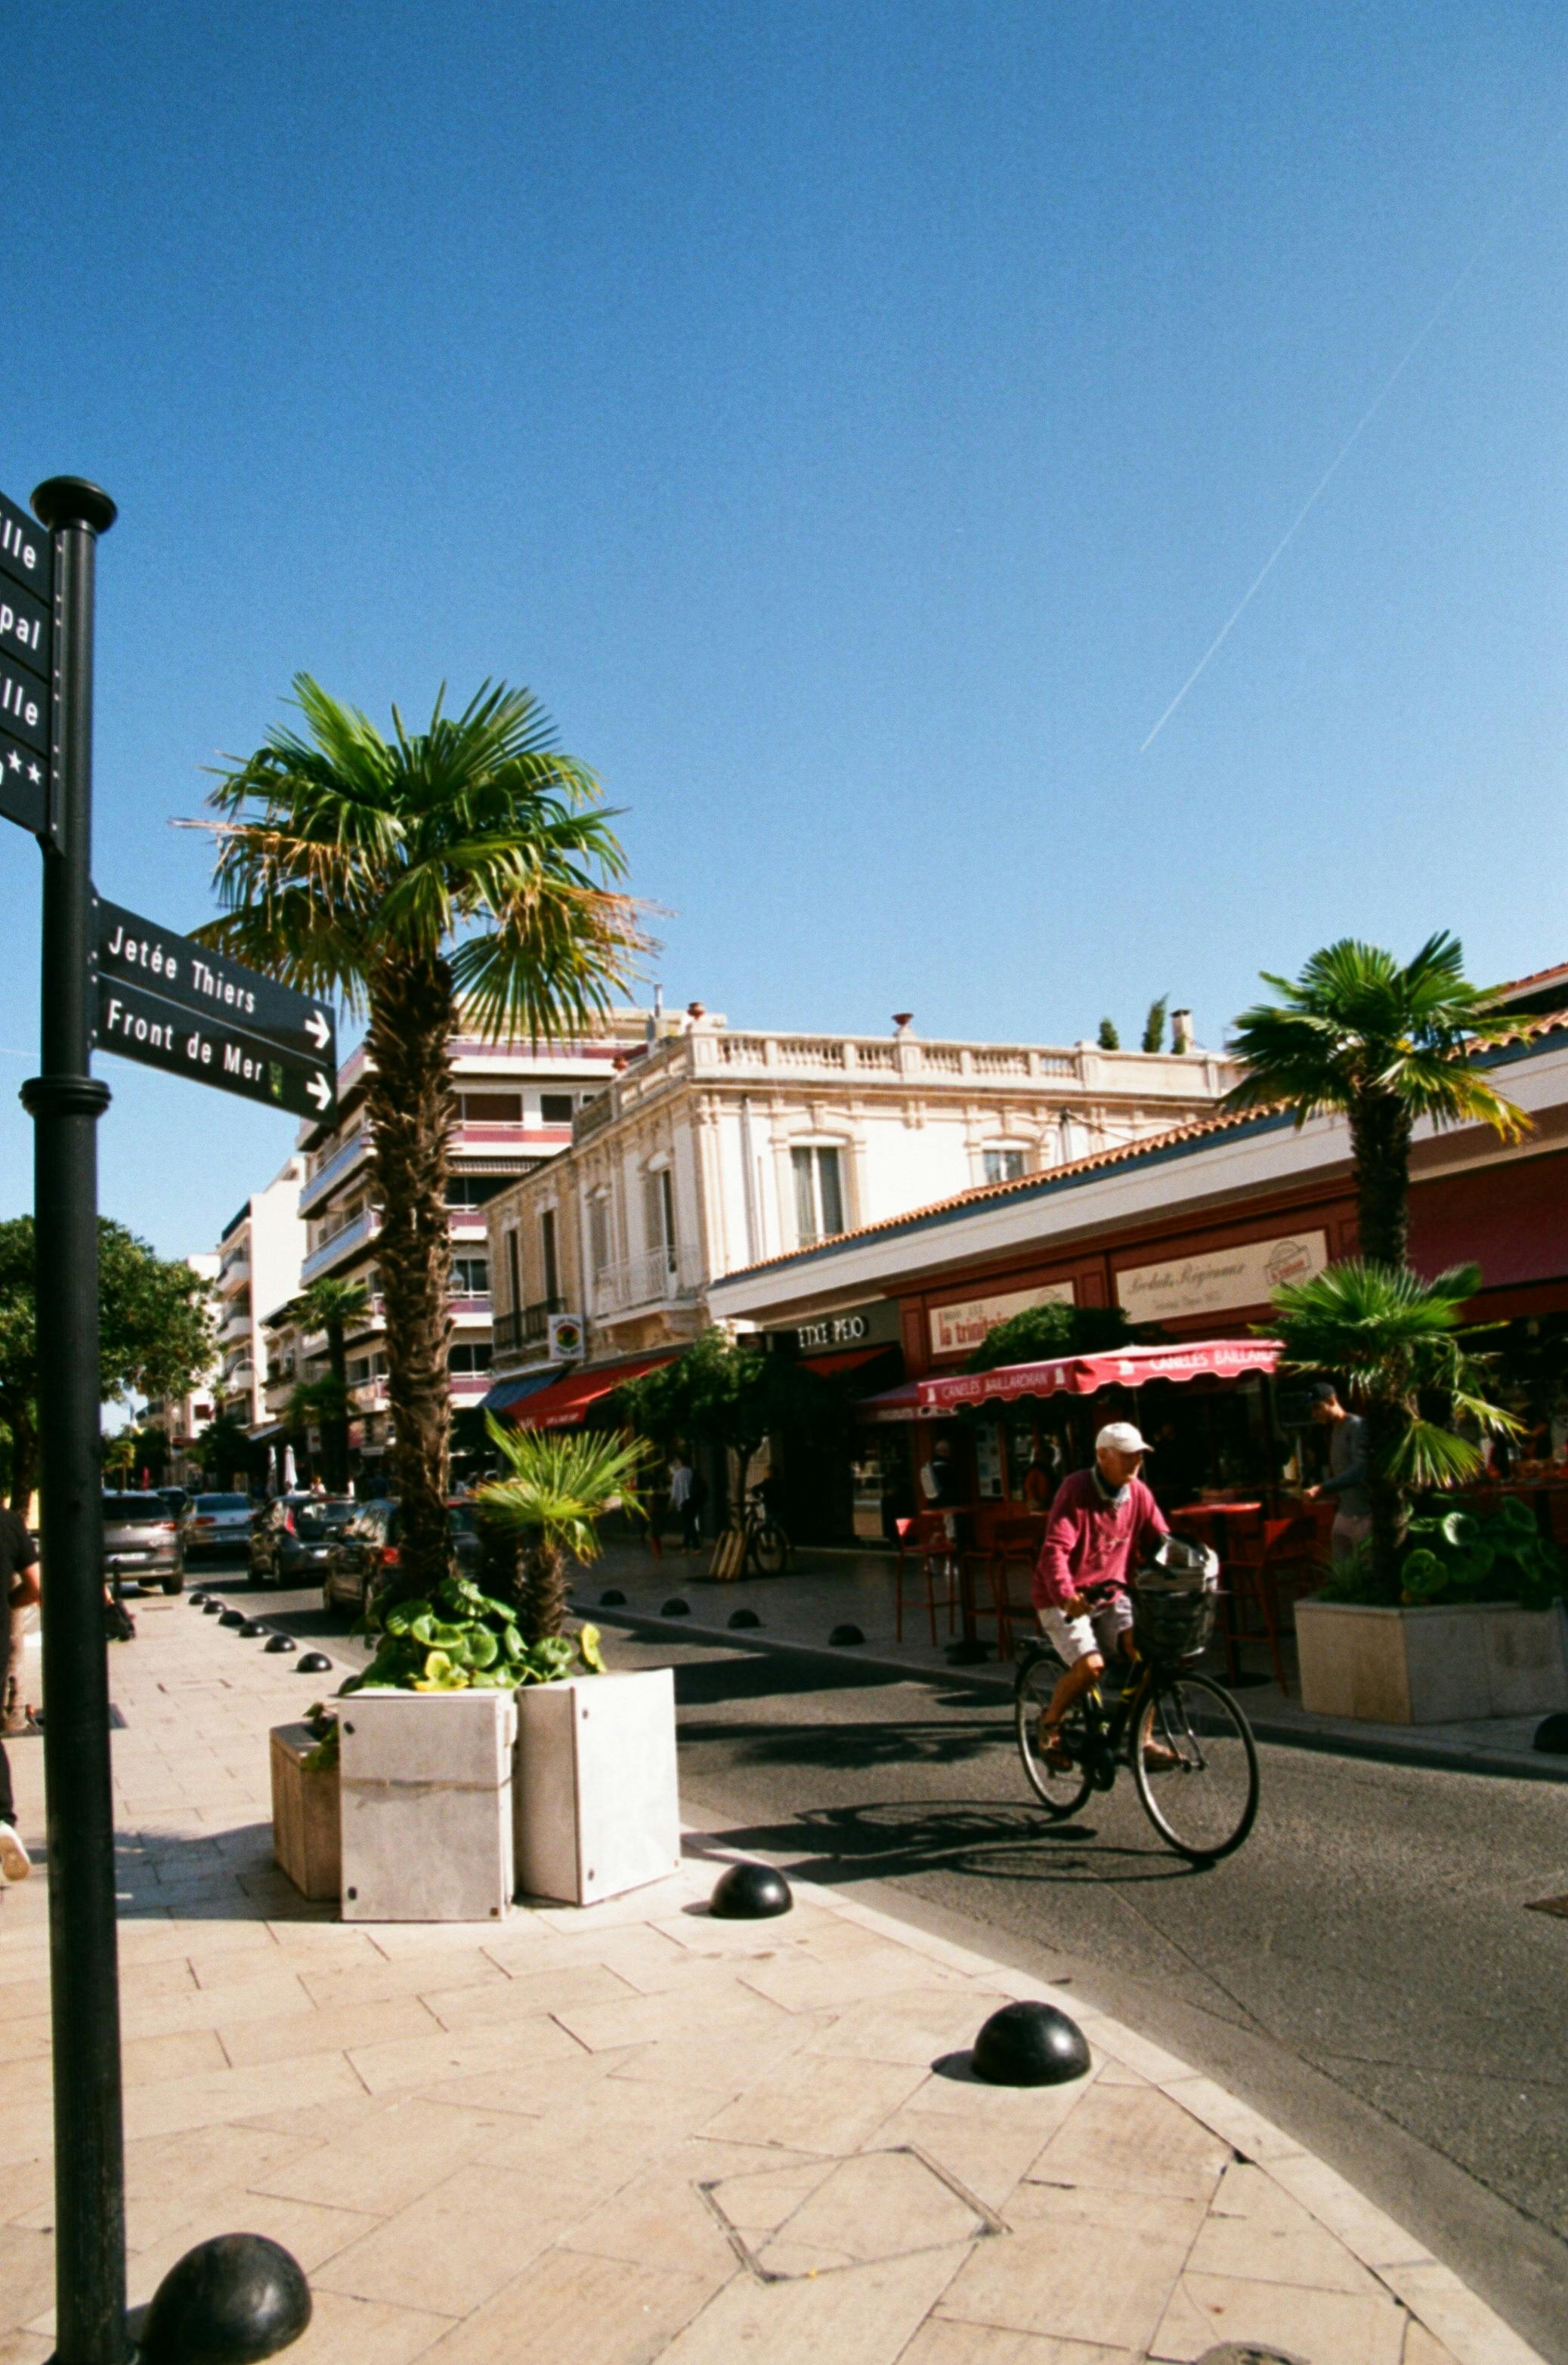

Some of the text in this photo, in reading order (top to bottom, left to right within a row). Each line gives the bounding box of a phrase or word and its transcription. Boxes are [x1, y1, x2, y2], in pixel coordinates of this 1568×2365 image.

[0, 511, 36, 569] lle
[0, 671, 39, 726] lle
[109, 926, 255, 1013] Jetée Thiers
[107, 999, 263, 1081] Front de Mer
